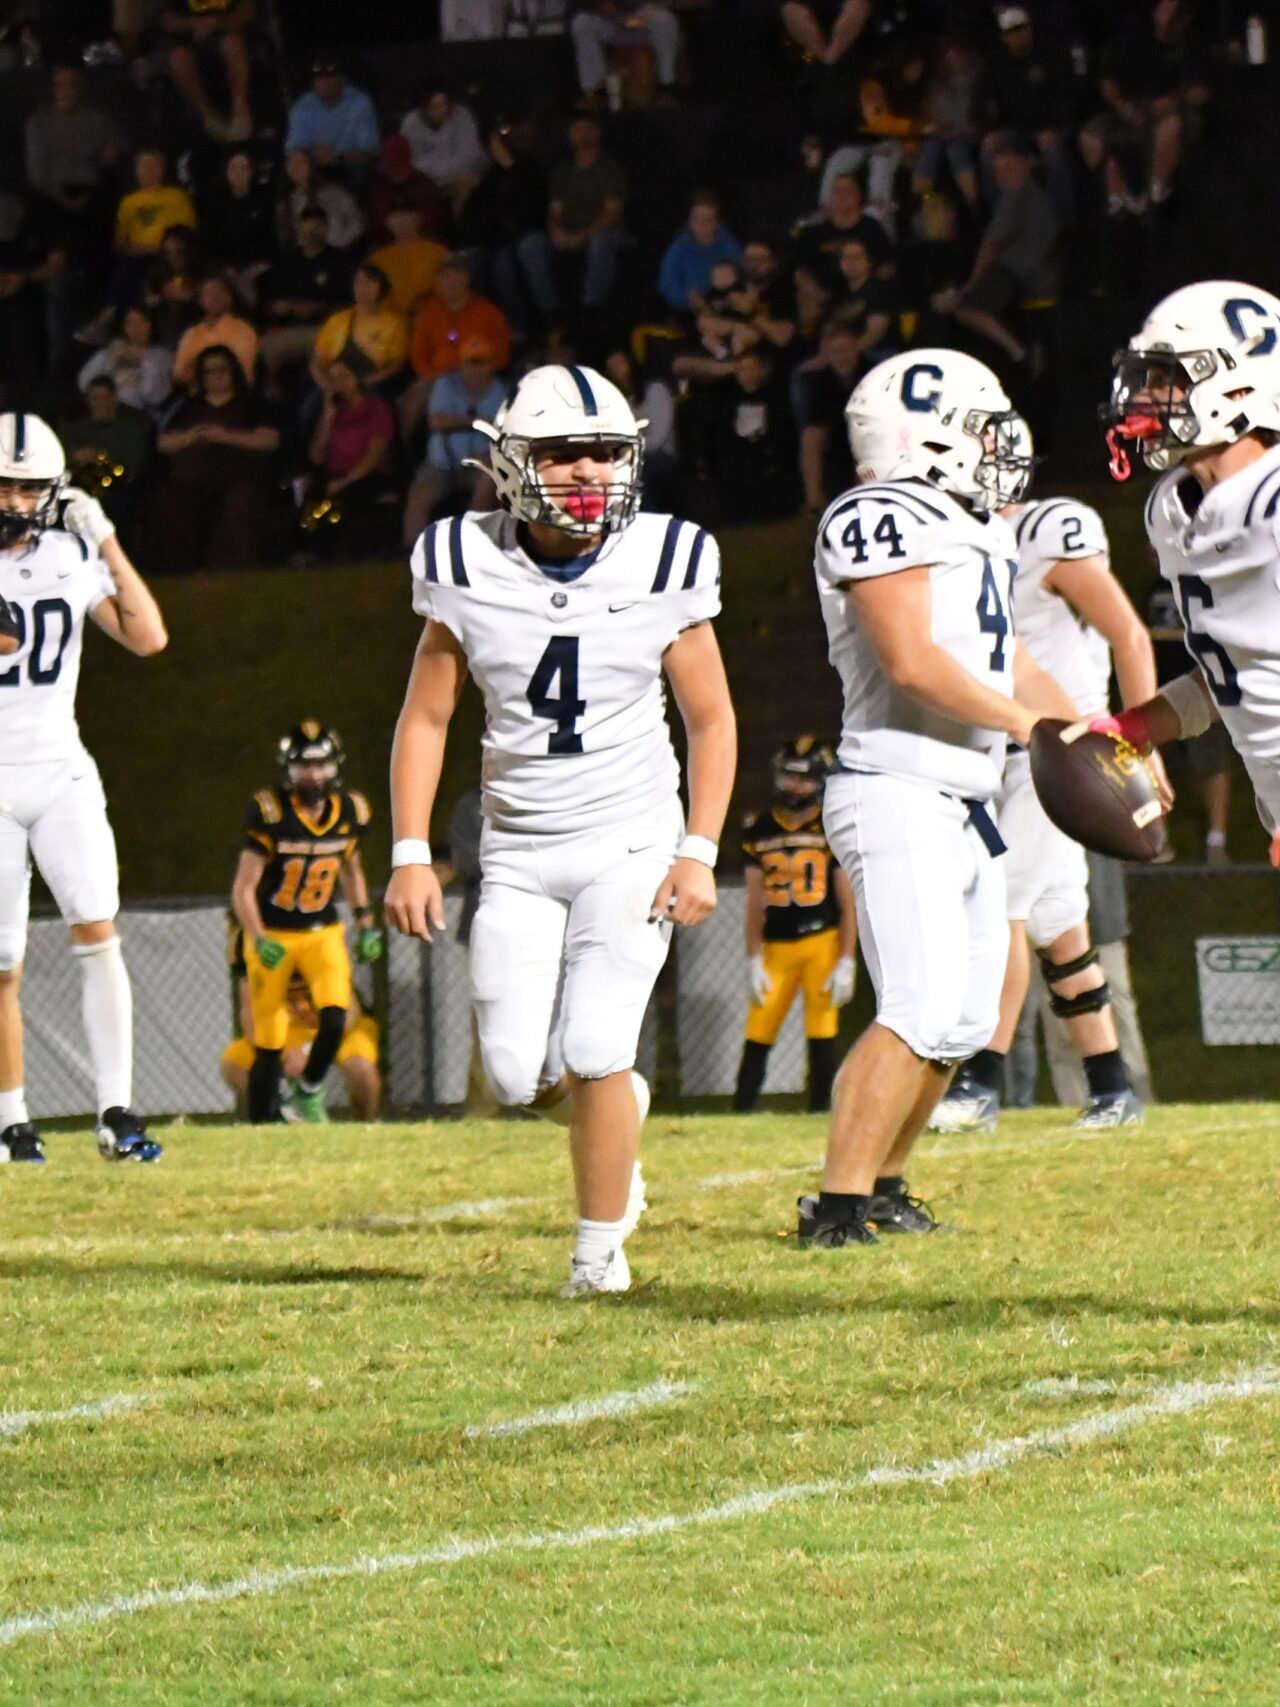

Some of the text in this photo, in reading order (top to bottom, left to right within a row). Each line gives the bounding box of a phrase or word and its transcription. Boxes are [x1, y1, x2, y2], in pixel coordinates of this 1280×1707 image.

[1219, 298, 1278, 356] C
[900, 363, 944, 413] C
[841, 513, 907, 564] 44
[1061, 516, 1087, 550] 2
[976, 553, 1018, 672] 4
[1178, 574, 1242, 706] 6
[526, 635, 587, 754] 4
[271, 857, 340, 914] 18
[760, 849, 828, 907] 20
